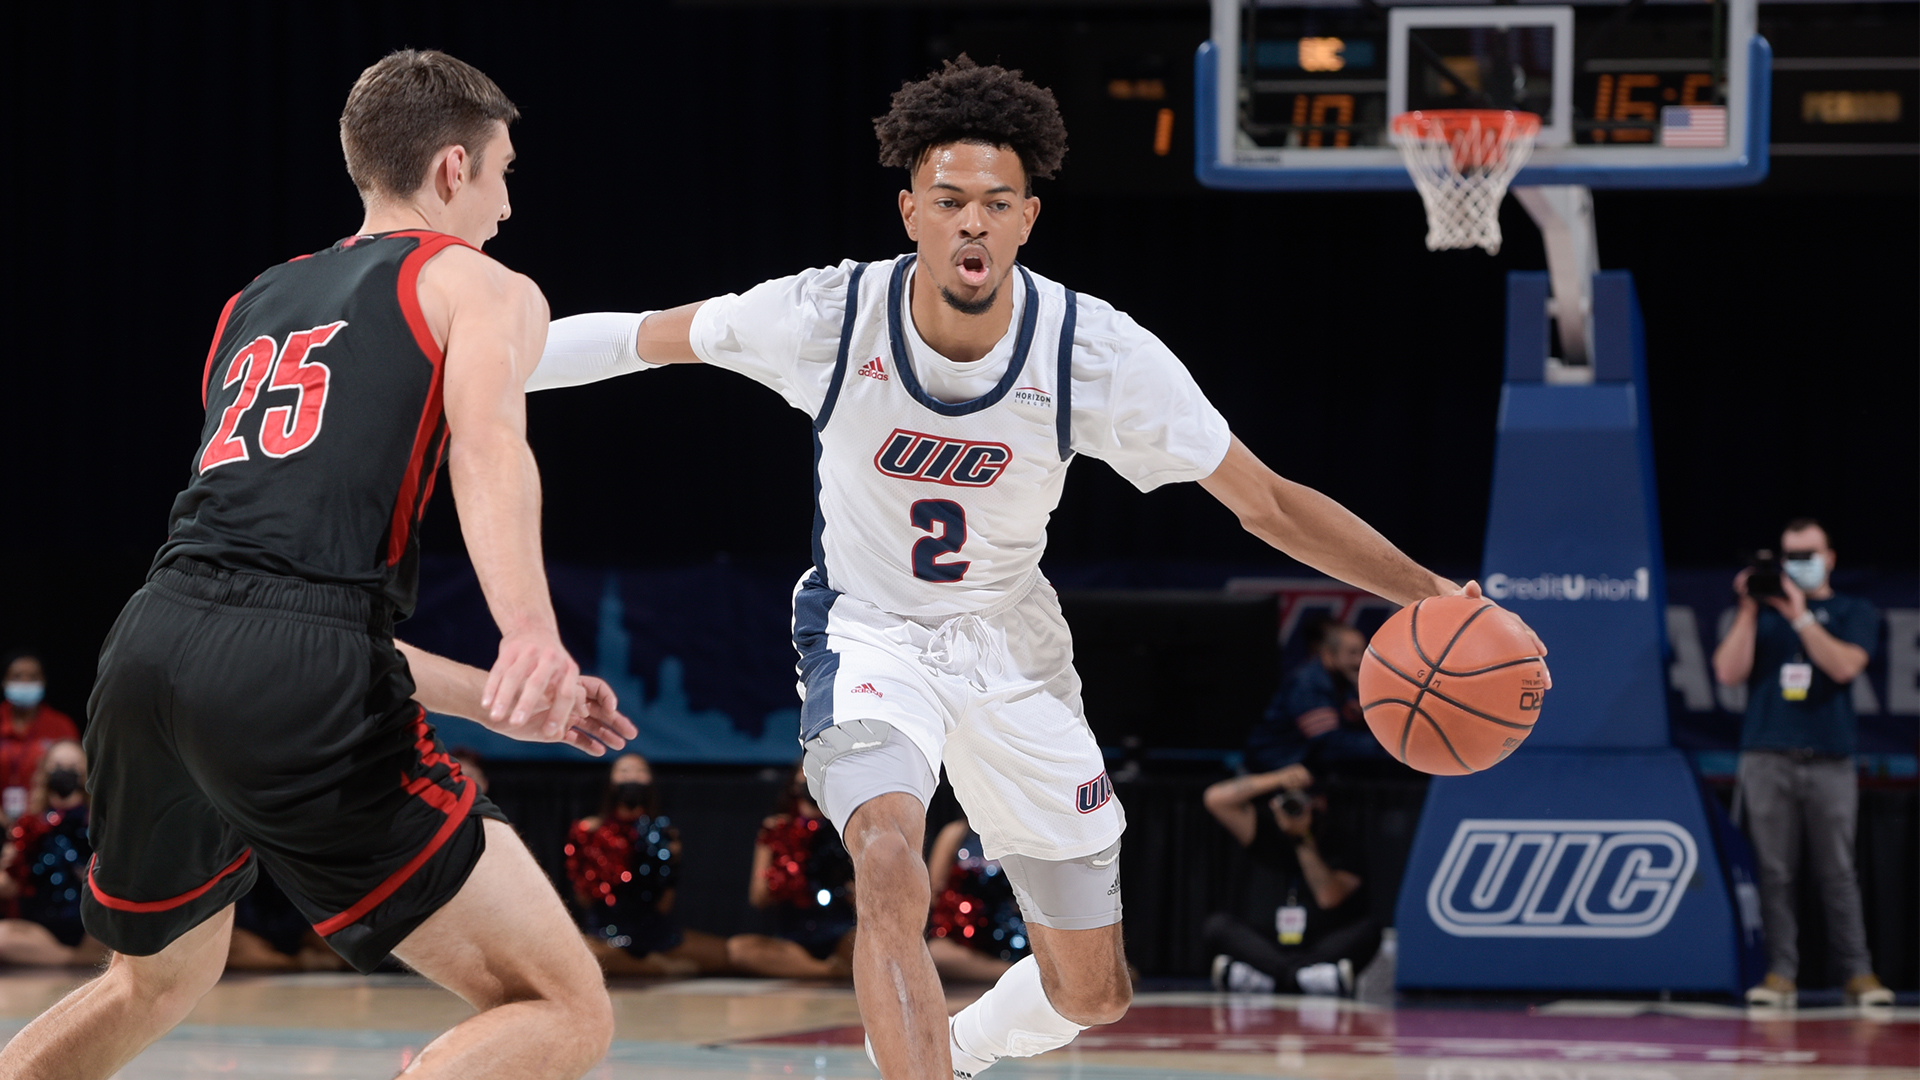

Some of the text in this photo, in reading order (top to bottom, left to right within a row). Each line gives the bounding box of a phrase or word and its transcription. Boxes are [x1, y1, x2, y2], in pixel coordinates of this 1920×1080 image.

[200, 320, 349, 476] 25
[858, 368, 889, 382] adidas
[1015, 391, 1052, 403] HORIZON
[875, 429, 1012, 487] UIC
[910, 498, 971, 583] 2
[1519, 691, 1544, 712] RO
[1434, 827, 1692, 930] UIC
